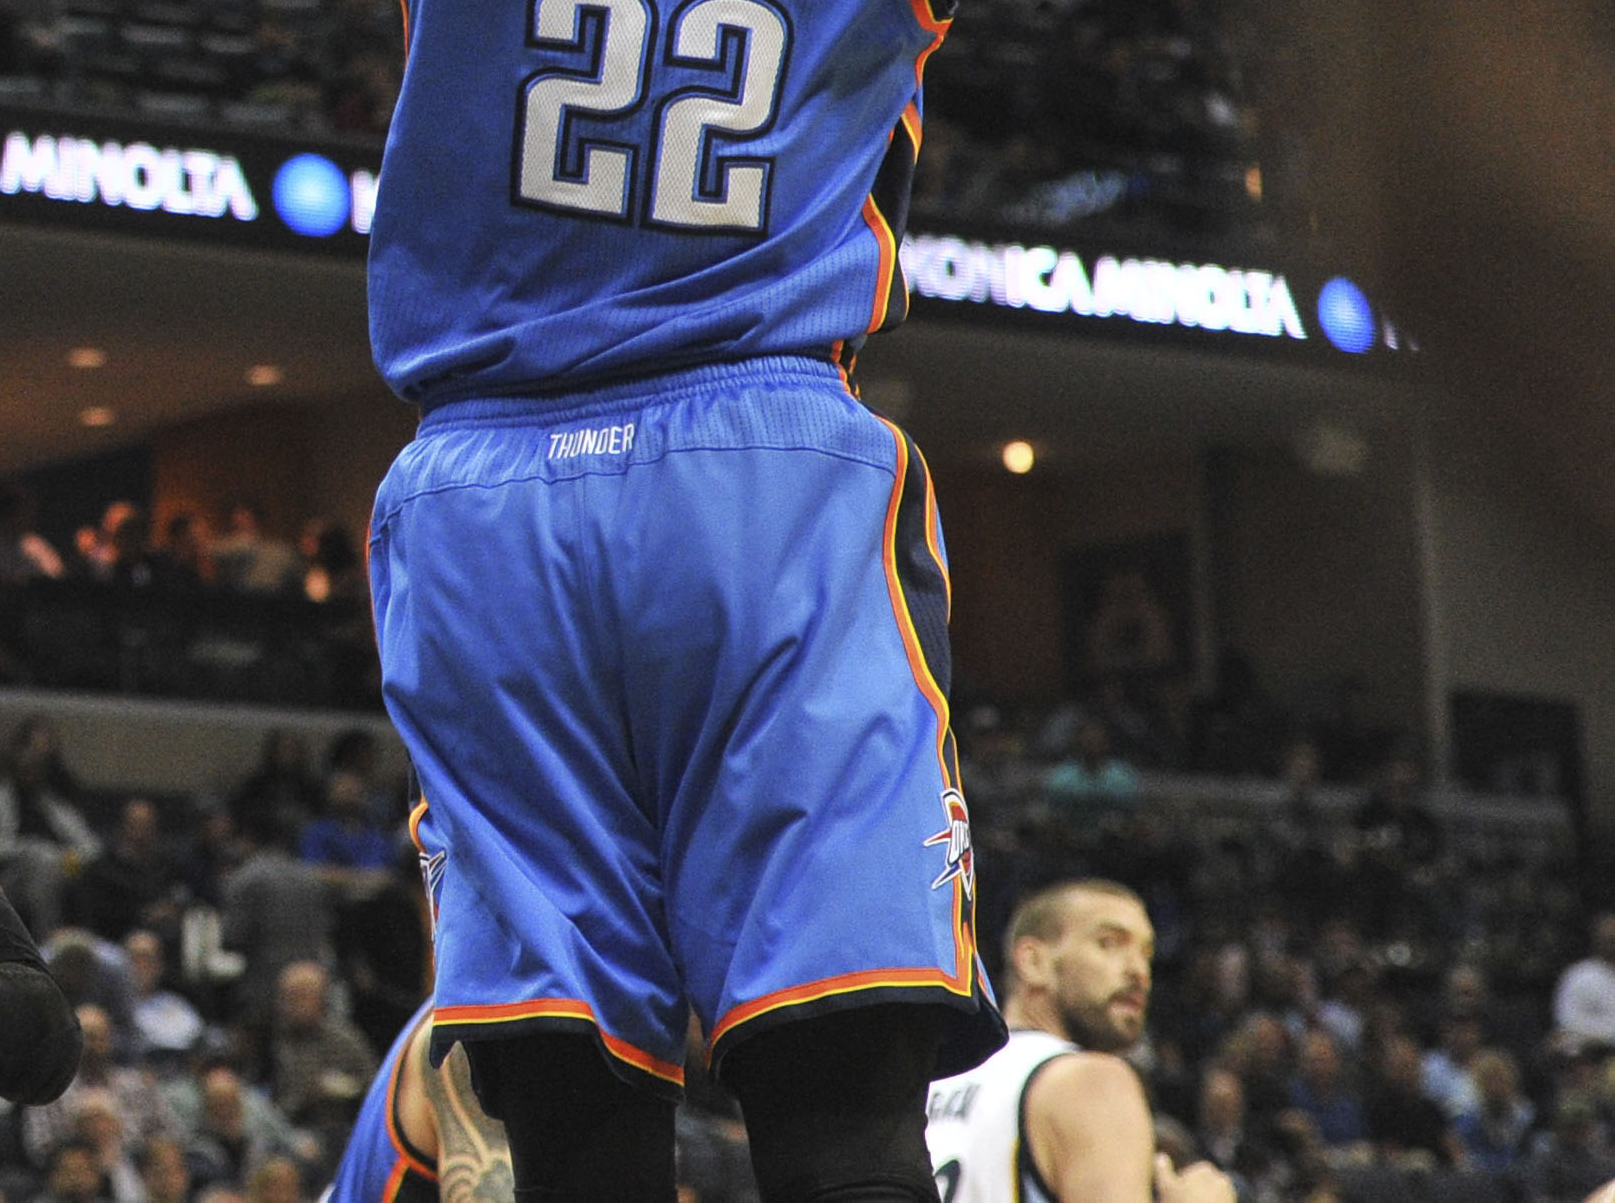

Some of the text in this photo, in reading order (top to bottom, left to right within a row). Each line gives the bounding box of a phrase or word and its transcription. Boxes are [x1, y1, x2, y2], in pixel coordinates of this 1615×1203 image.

[0, 130, 259, 222] MINOLTA
[1093, 255, 1308, 340] MINOLTA
[548, 423, 635, 460] THUNDER
